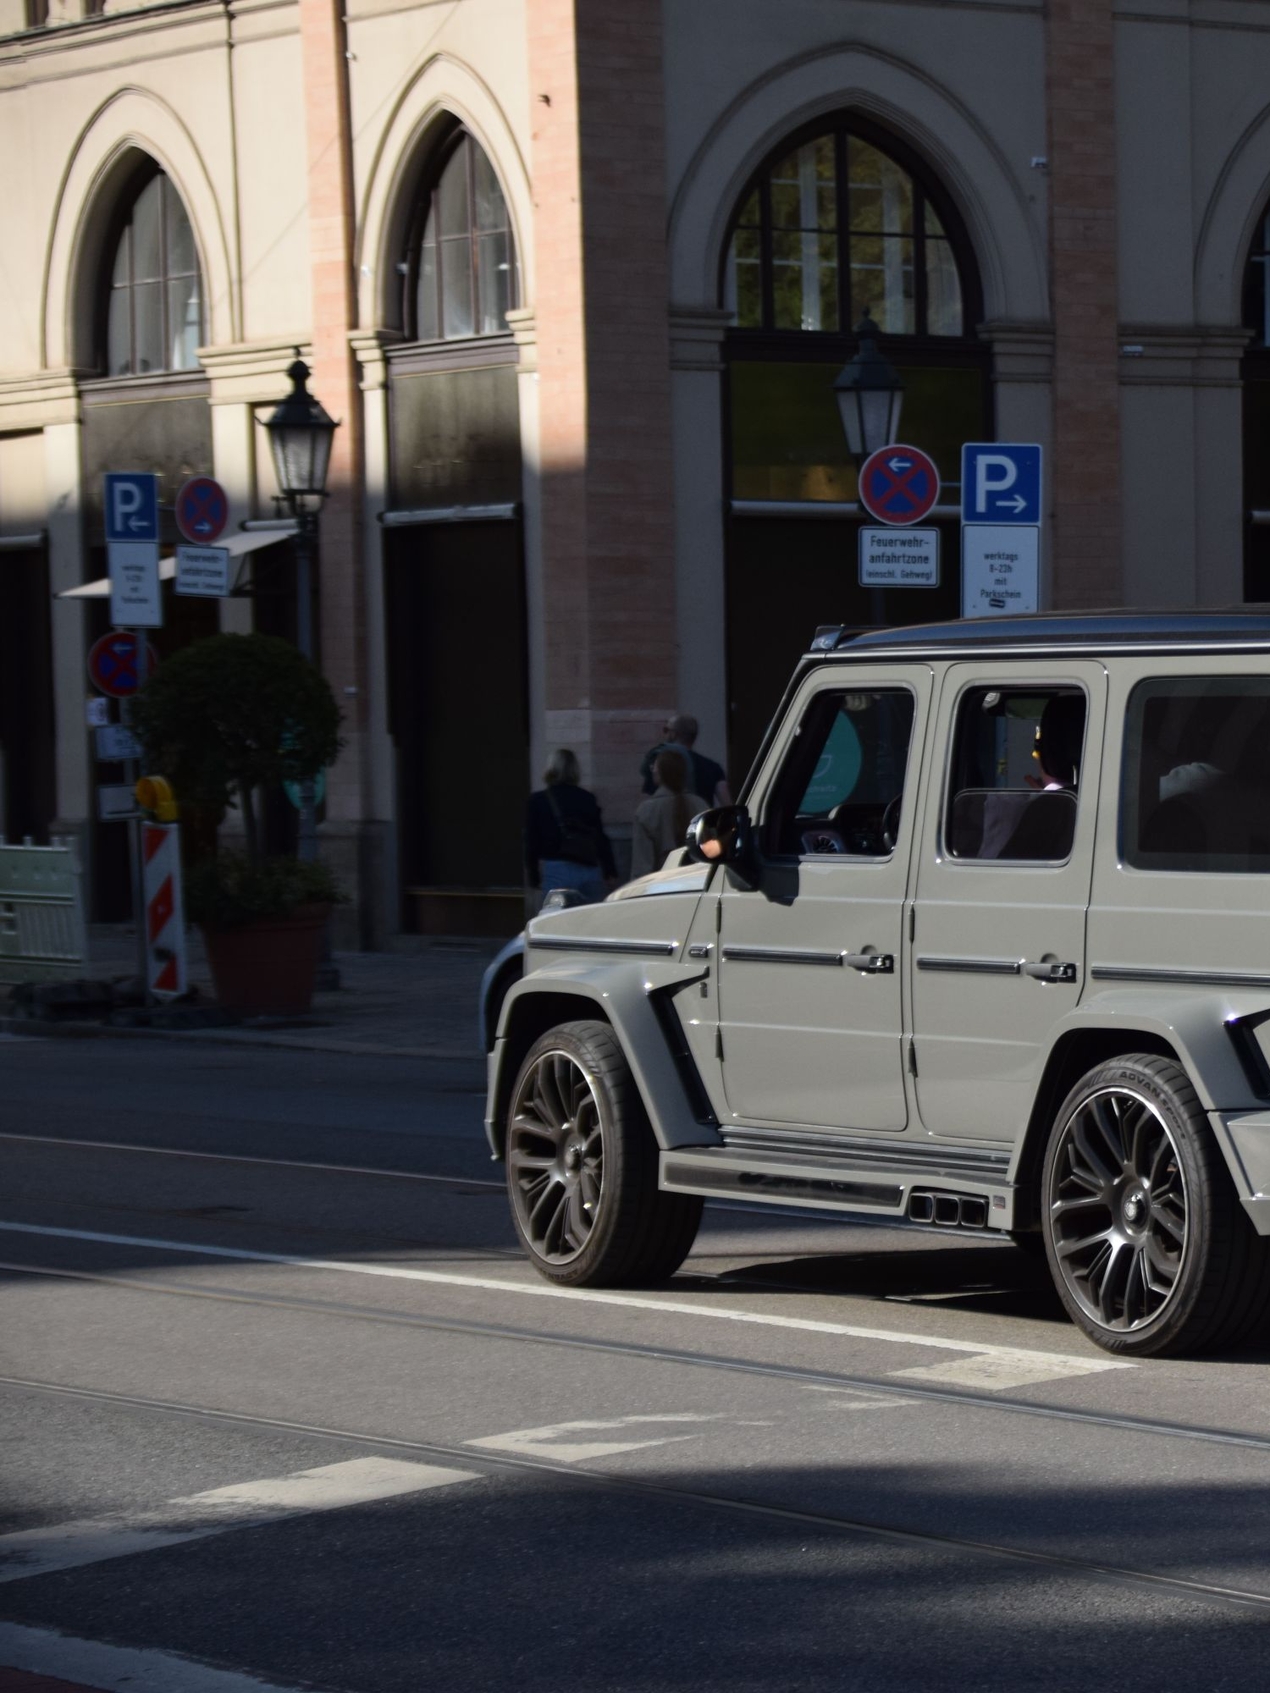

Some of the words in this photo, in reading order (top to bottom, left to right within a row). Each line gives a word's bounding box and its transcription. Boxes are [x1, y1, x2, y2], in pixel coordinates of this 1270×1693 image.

[975, 454, 1017, 513] P
[113, 482, 142, 532] P
[870, 535, 930, 548] Feuerwehr-
[869, 553, 929, 565] anfahrtzone
[984, 552, 1018, 562] werktags
[994, 577, 1007, 586] mit
[980, 589, 1021, 599] Parkschein
[1119, 1071, 1161, 1098] ADVAN
